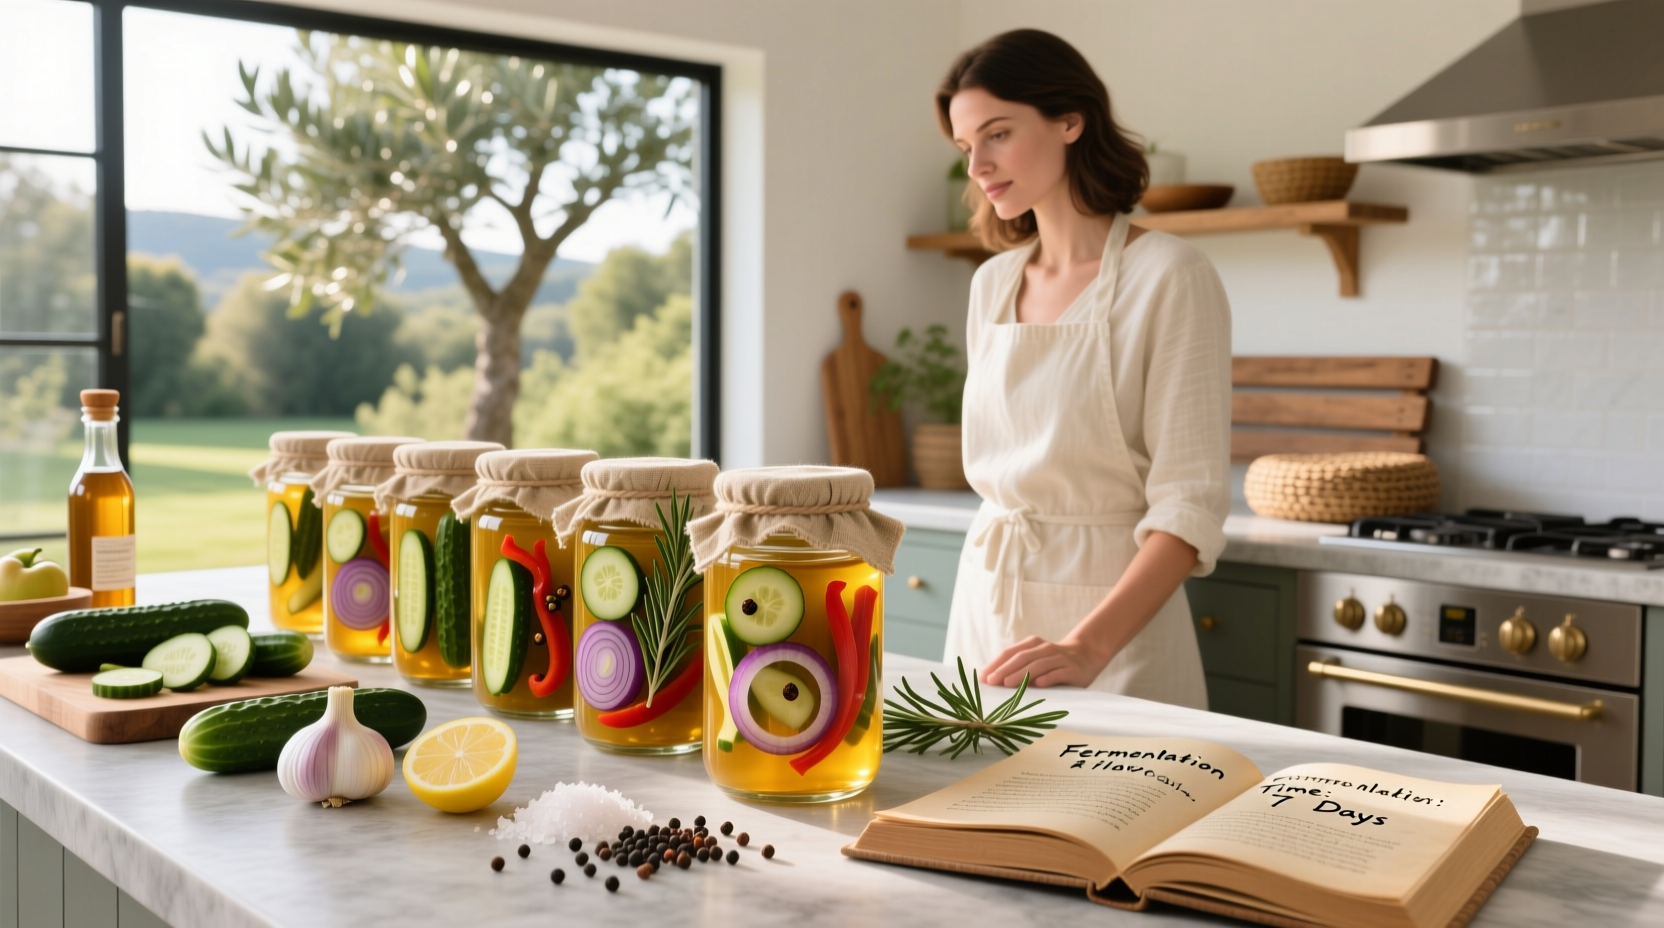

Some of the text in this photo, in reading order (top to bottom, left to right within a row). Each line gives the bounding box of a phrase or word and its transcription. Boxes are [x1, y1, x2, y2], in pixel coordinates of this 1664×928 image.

[1260, 783, 1332, 798] Time:
[1270, 794, 1388, 826] 7 Days
